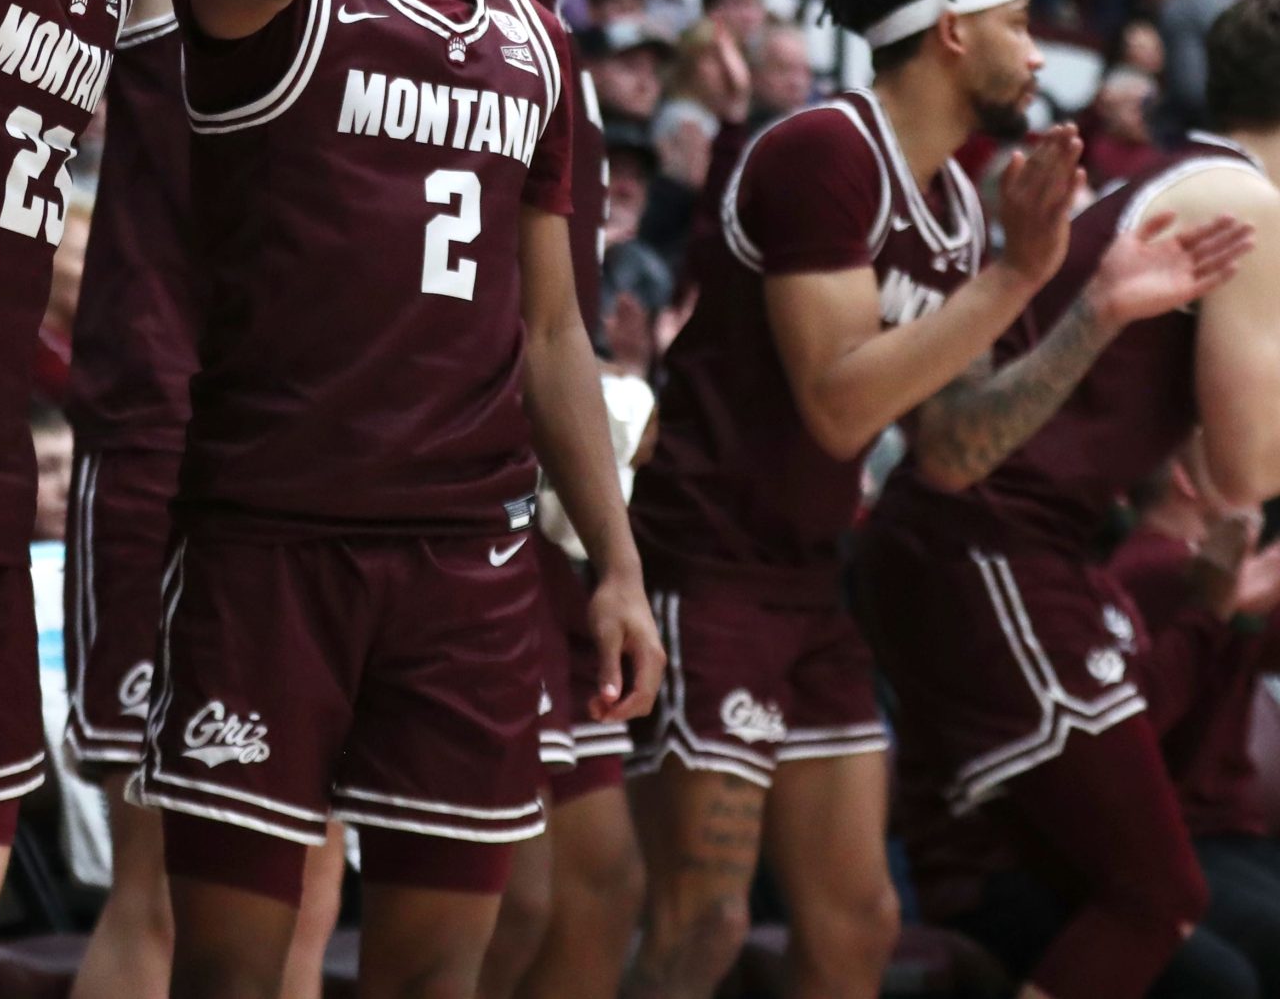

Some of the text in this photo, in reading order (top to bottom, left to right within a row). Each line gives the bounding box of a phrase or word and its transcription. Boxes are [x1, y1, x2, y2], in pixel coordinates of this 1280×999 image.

[337, 68, 541, 169] MONTANA
[421, 169, 482, 301] 2
[184, 700, 271, 764] Griz
